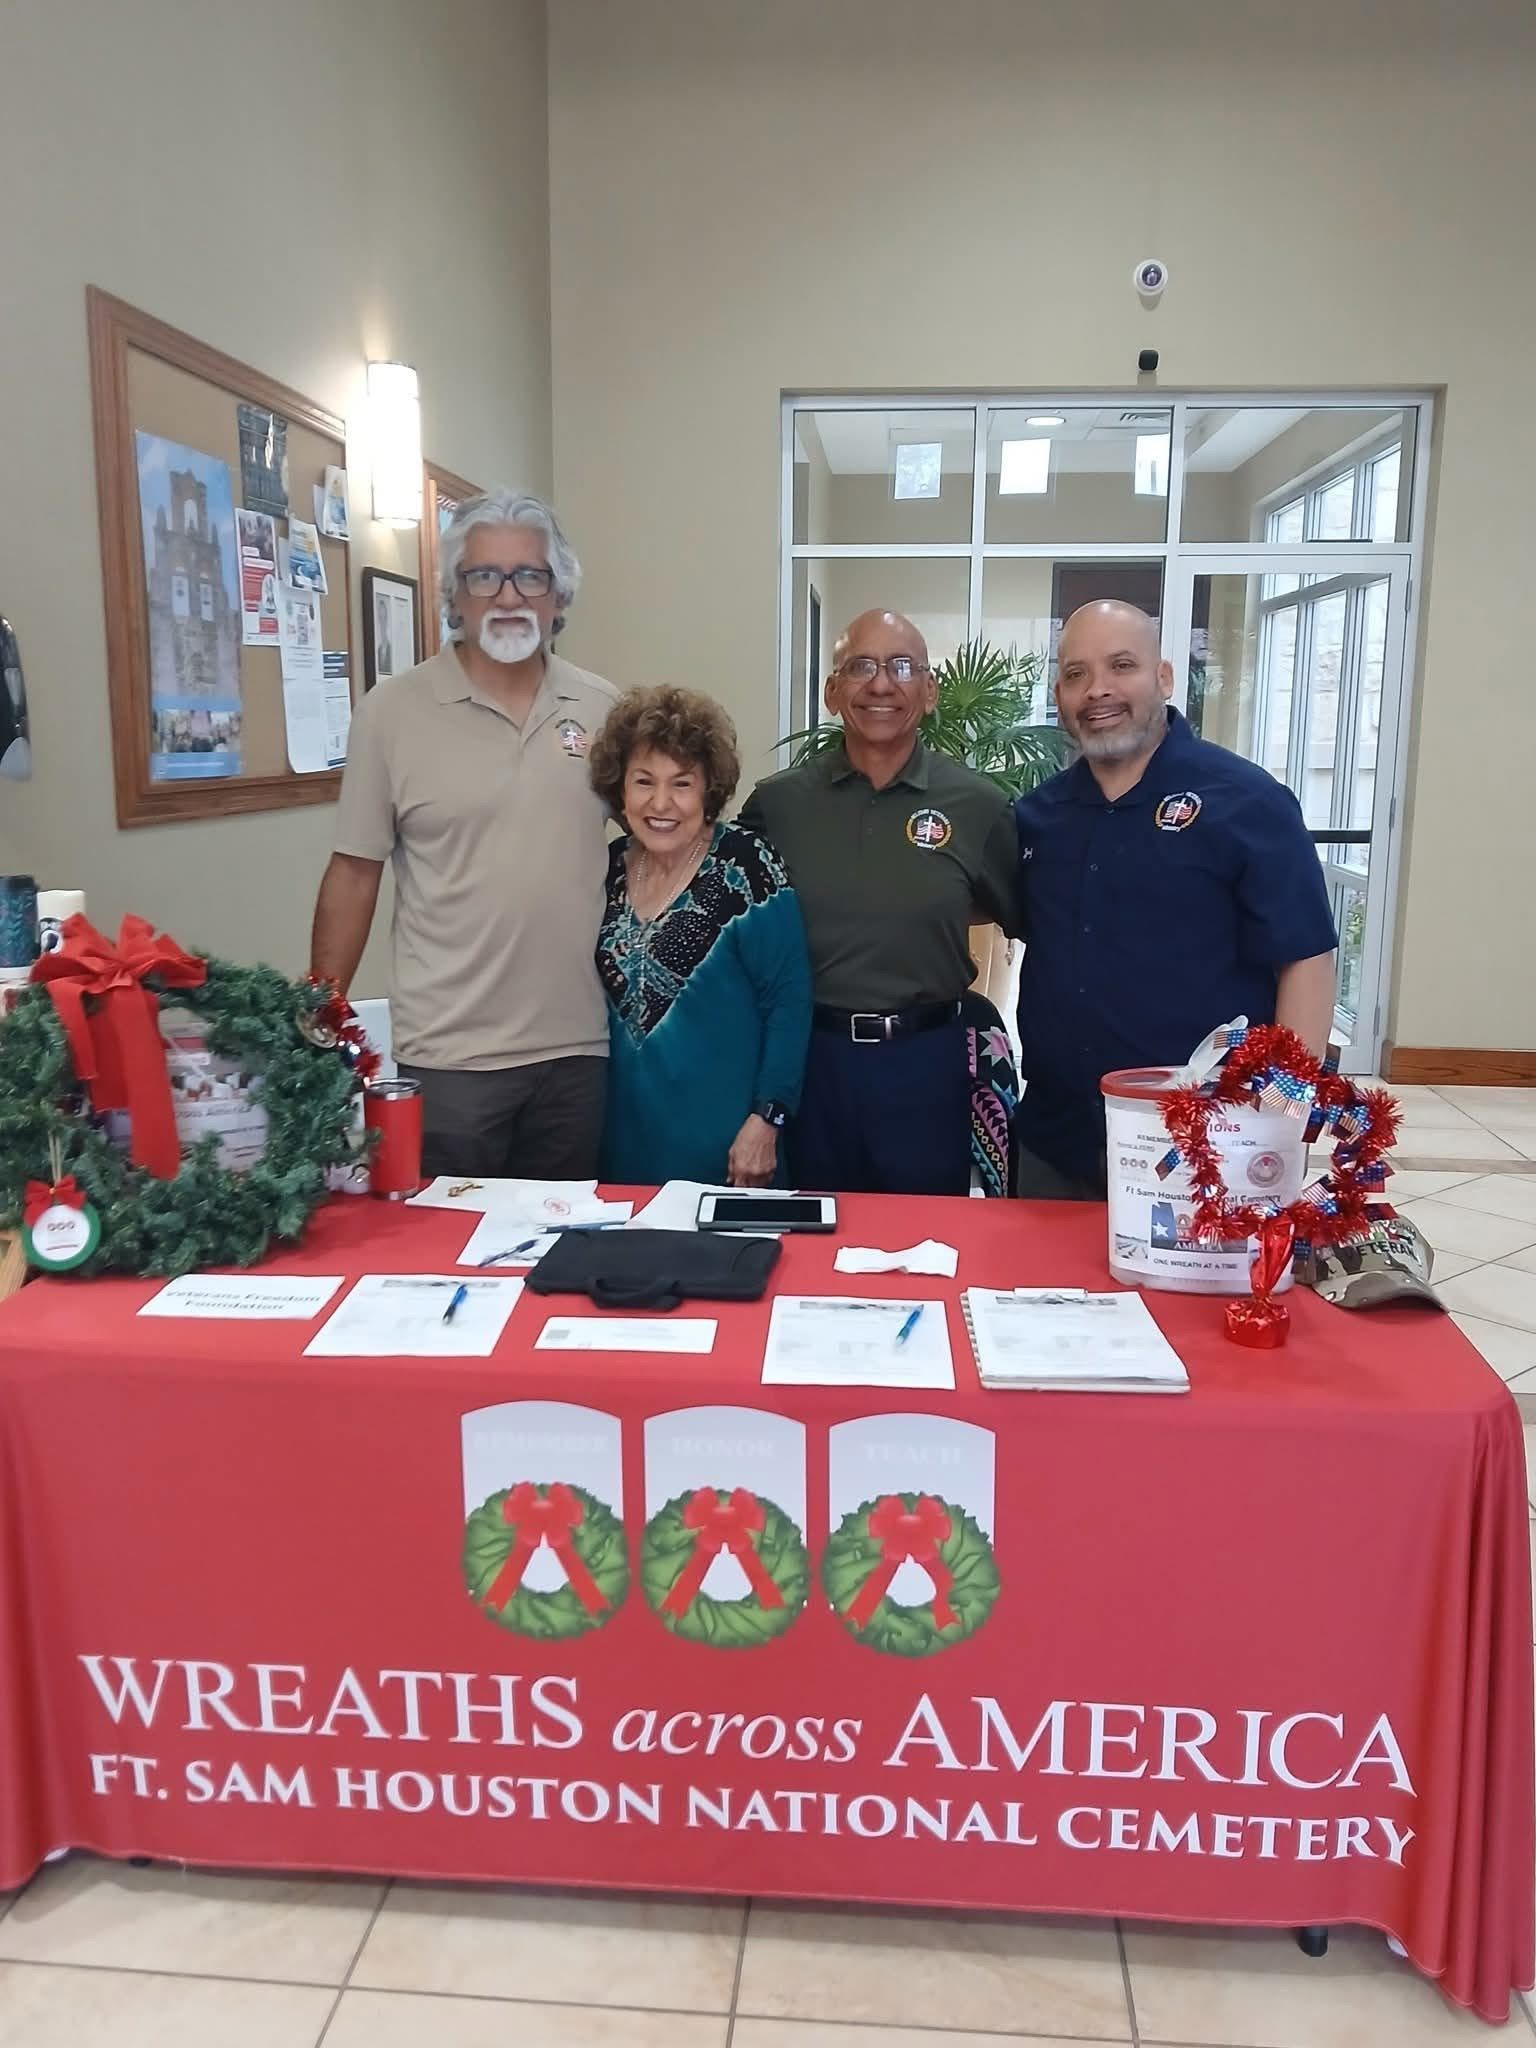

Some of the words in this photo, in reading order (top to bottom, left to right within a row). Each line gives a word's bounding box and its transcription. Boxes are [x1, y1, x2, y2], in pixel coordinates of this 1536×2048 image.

[1208, 1122, 1242, 1134] IONS
[1125, 1185, 1135, 1195] Ft
[1136, 1188, 1156, 1198] Sam
[1157, 1190, 1192, 1203] Housto
[1356, 1240, 1416, 1262] ETERAN
[1169, 1260, 1201, 1269] WREATH
[184, 1300, 285, 1310] Foundation
[244, 1291, 321, 1302] Freedom
[671, 1437, 776, 1457] HONOR
[863, 1441, 962, 1463] TEACH
[78, 1655, 583, 1749] WREATHS
[612, 1709, 863, 1763] across
[883, 1692, 1418, 1798] AMERICA
[90, 1754, 168, 1800] FT.
[185, 1760, 315, 1808] SAM
[335, 1767, 662, 1826] HOUSTON
[687, 1785, 1038, 1847] NATIONAL
[1057, 1806, 1417, 1867] CEMETERY
